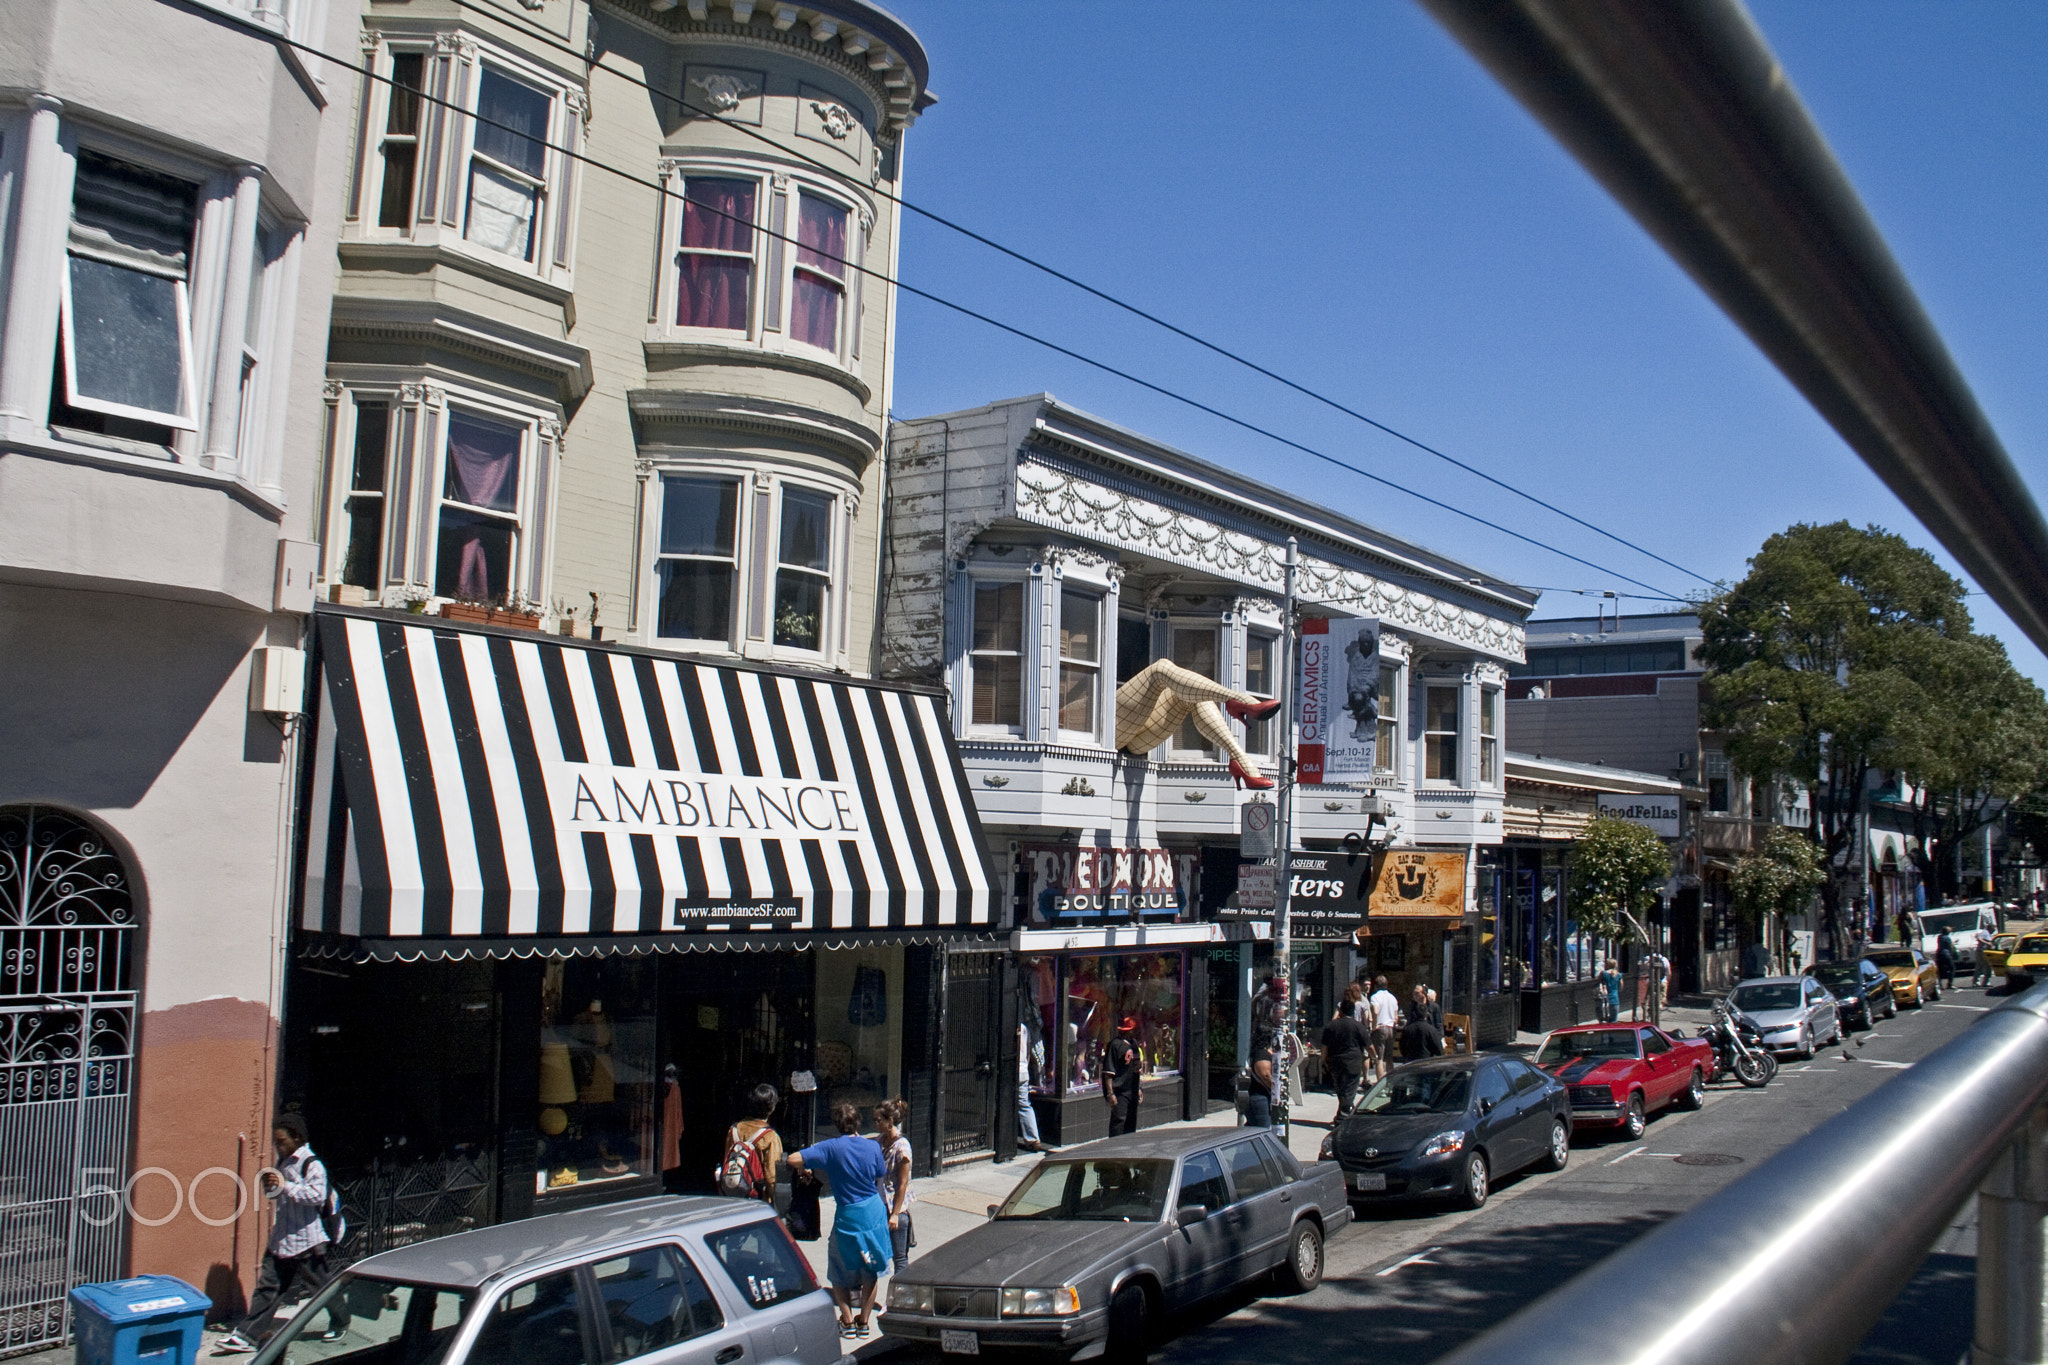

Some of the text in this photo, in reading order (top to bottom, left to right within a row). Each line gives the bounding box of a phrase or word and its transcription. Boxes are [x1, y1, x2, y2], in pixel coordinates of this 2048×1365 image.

[1302, 640, 1320, 741] CERAMICS
[1318, 645, 1330, 741] Annual of America
[1302, 763, 1321, 772] CAA
[570, 773, 859, 832] AMBIANCE
[1599, 804, 1678, 819] GoodFellas
[1290, 858, 1329, 869] ASHBURY
[1240, 866, 1273, 877] NO PARKING
[1026, 849, 1198, 923] PIEDMONT
[1290, 874, 1345, 899] ters
[1054, 893, 1179, 911] BOUTIQUE
[680, 903, 797, 919] www.ambianceSF.com
[1240, 907, 1259, 915] Prints
[1261, 908, 1276, 916] Card
[1311, 910, 1326, 918] Gifts
[1334, 911, 1362, 919] Souvenirs
[1293, 924, 1343, 937] PIPES
[1207, 949, 1241, 962] PIPES
